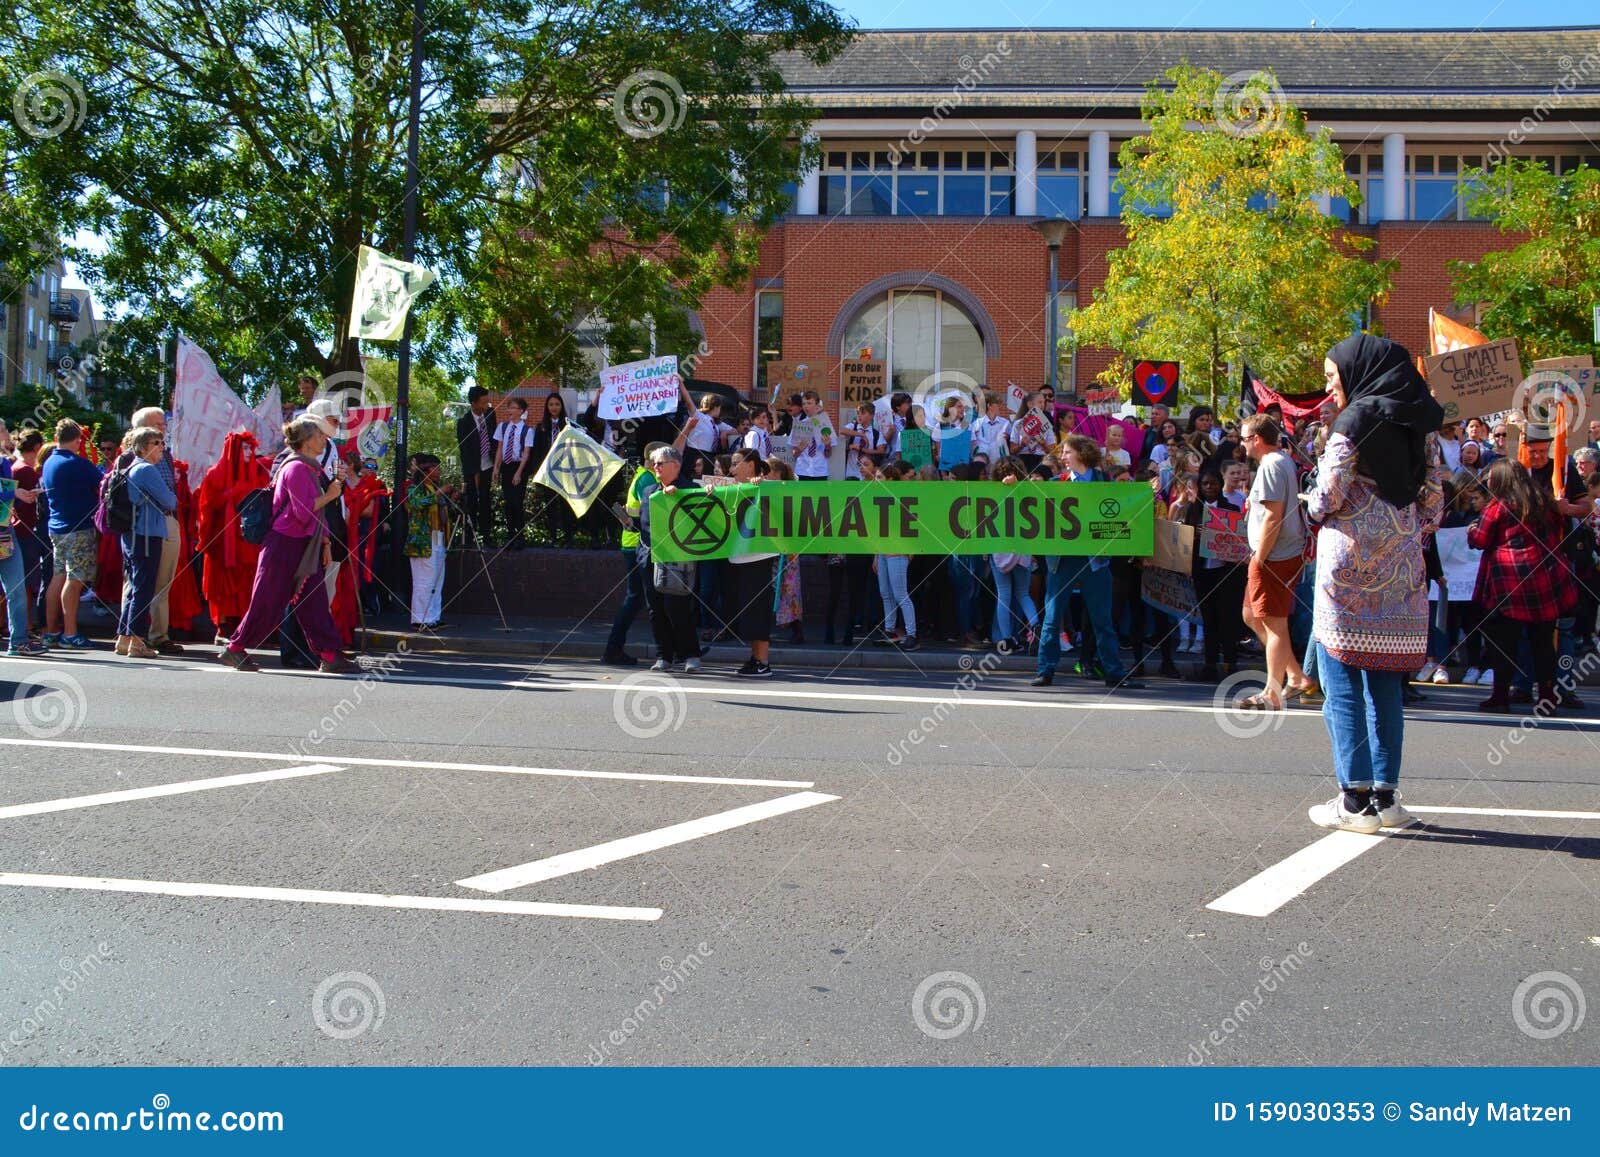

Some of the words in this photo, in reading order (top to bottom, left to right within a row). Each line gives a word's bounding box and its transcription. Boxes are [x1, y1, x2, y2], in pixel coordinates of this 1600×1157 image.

[1440, 342, 1514, 374] CLIMATE
[610, 372, 630, 385] THE
[634, 363, 676, 379] CLIMATE
[845, 363, 864, 373] FOR
[865, 363, 882, 373] OUR
[1453, 364, 1500, 382] CHANGE
[1579, 369, 1590, 380] IS
[850, 376, 882, 385] FUTURE
[617, 384, 625, 395] IS
[844, 386, 883, 402] KIDS
[611, 396, 625, 406] SO
[625, 392, 650, 403] WHY
[627, 400, 652, 412] WE?
[736, 496, 919, 539] CLIMATE
[948, 496, 1082, 540] CRISIS
